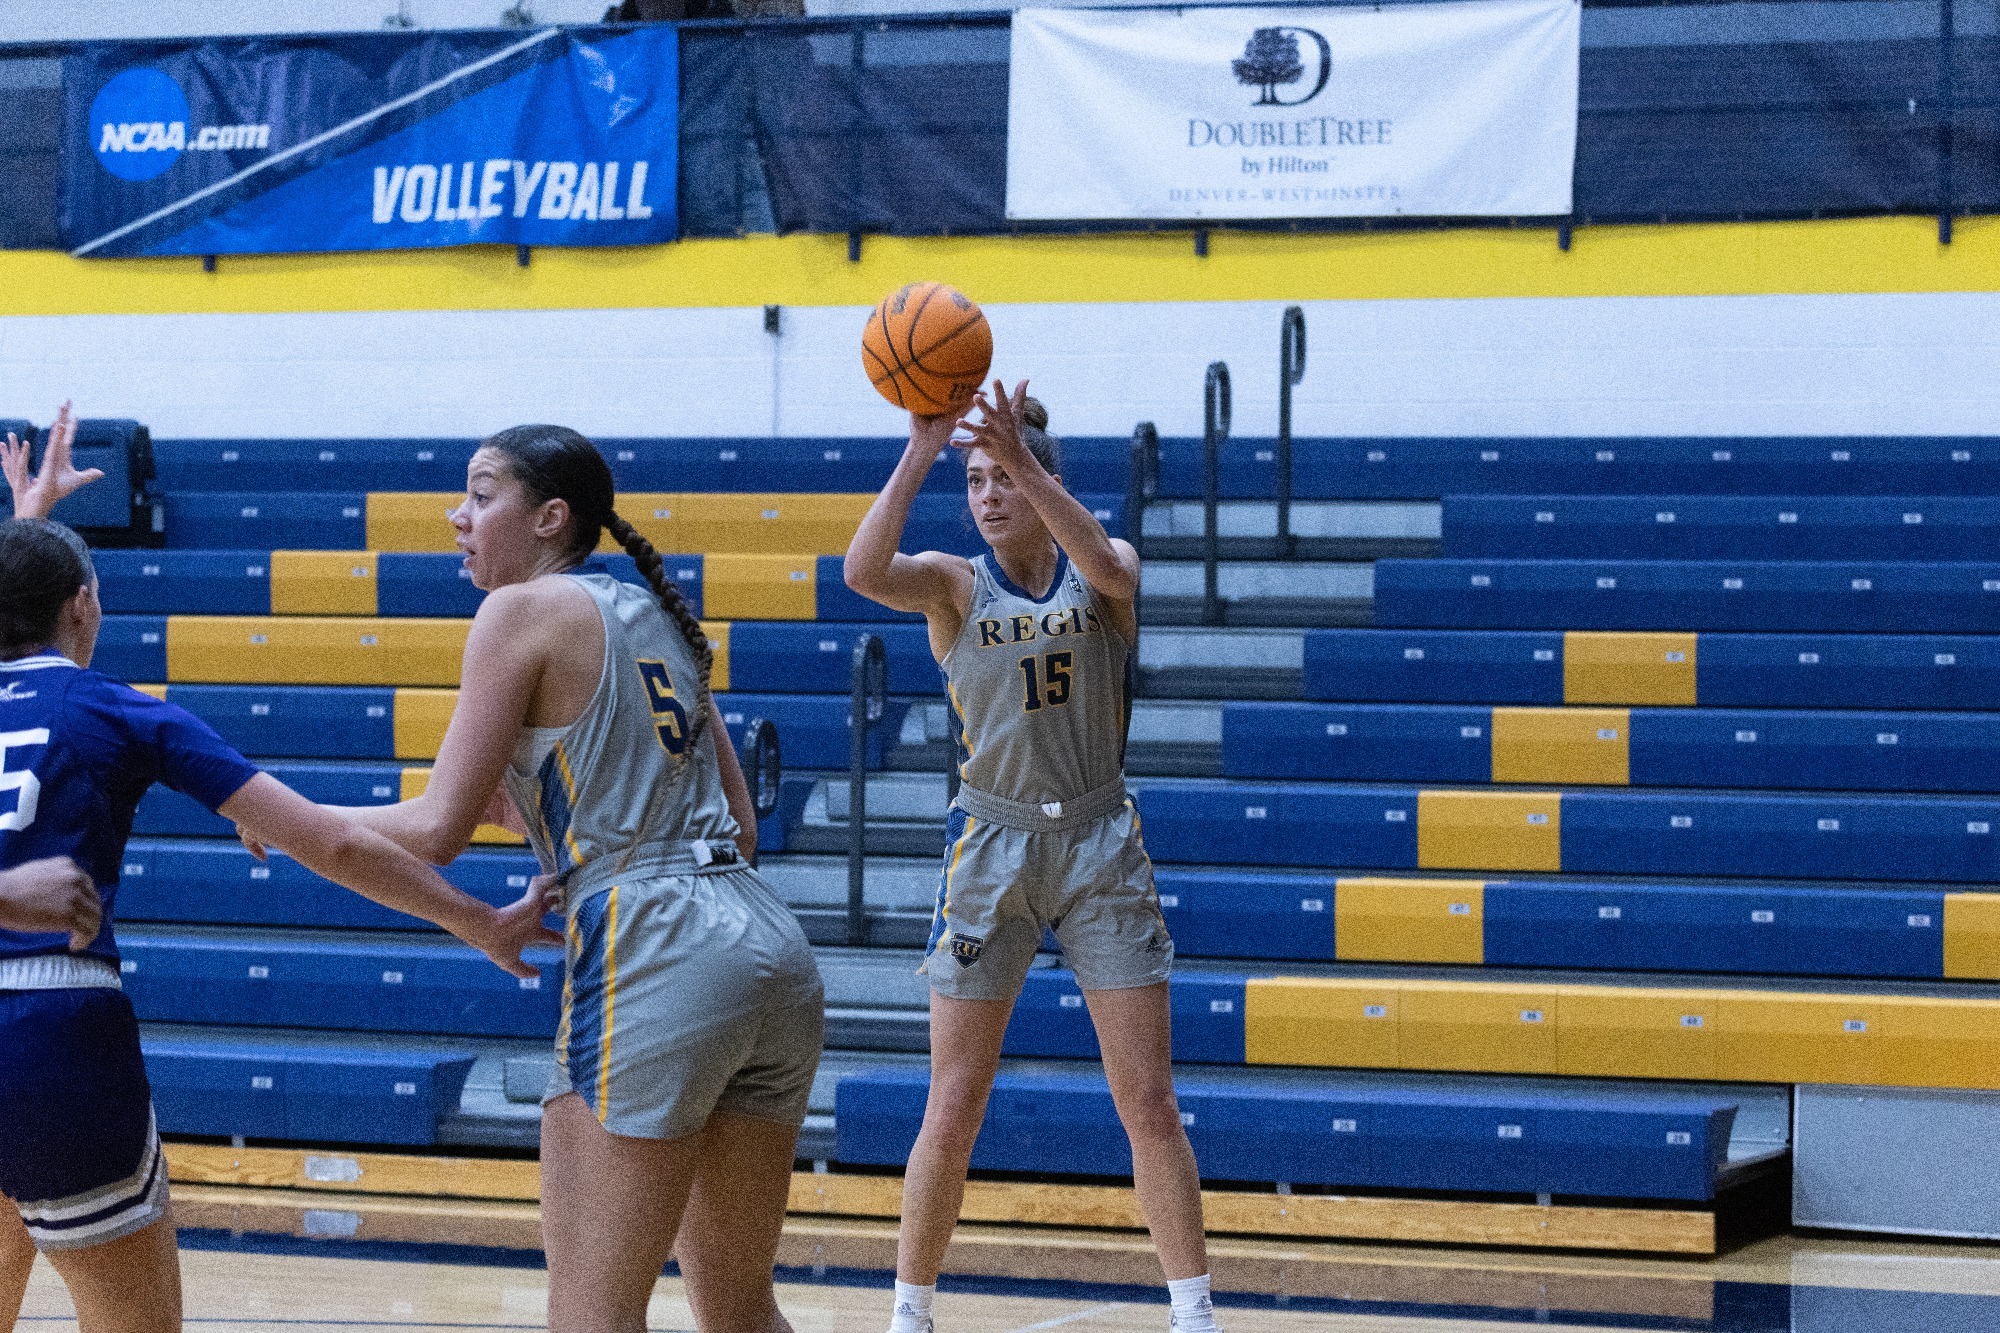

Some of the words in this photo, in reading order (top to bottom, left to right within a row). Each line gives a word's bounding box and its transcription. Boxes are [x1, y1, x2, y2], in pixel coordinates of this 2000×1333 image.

[100, 121, 269, 153] NCAA.com
[372, 159, 652, 224] VOLLEYBALL
[1241, 156, 1262, 178] by
[1269, 155, 1328, 173] Hilton
[977, 607, 1101, 648] REGIS
[1019, 651, 1074, 713] 15
[636, 658, 690, 758] 5
